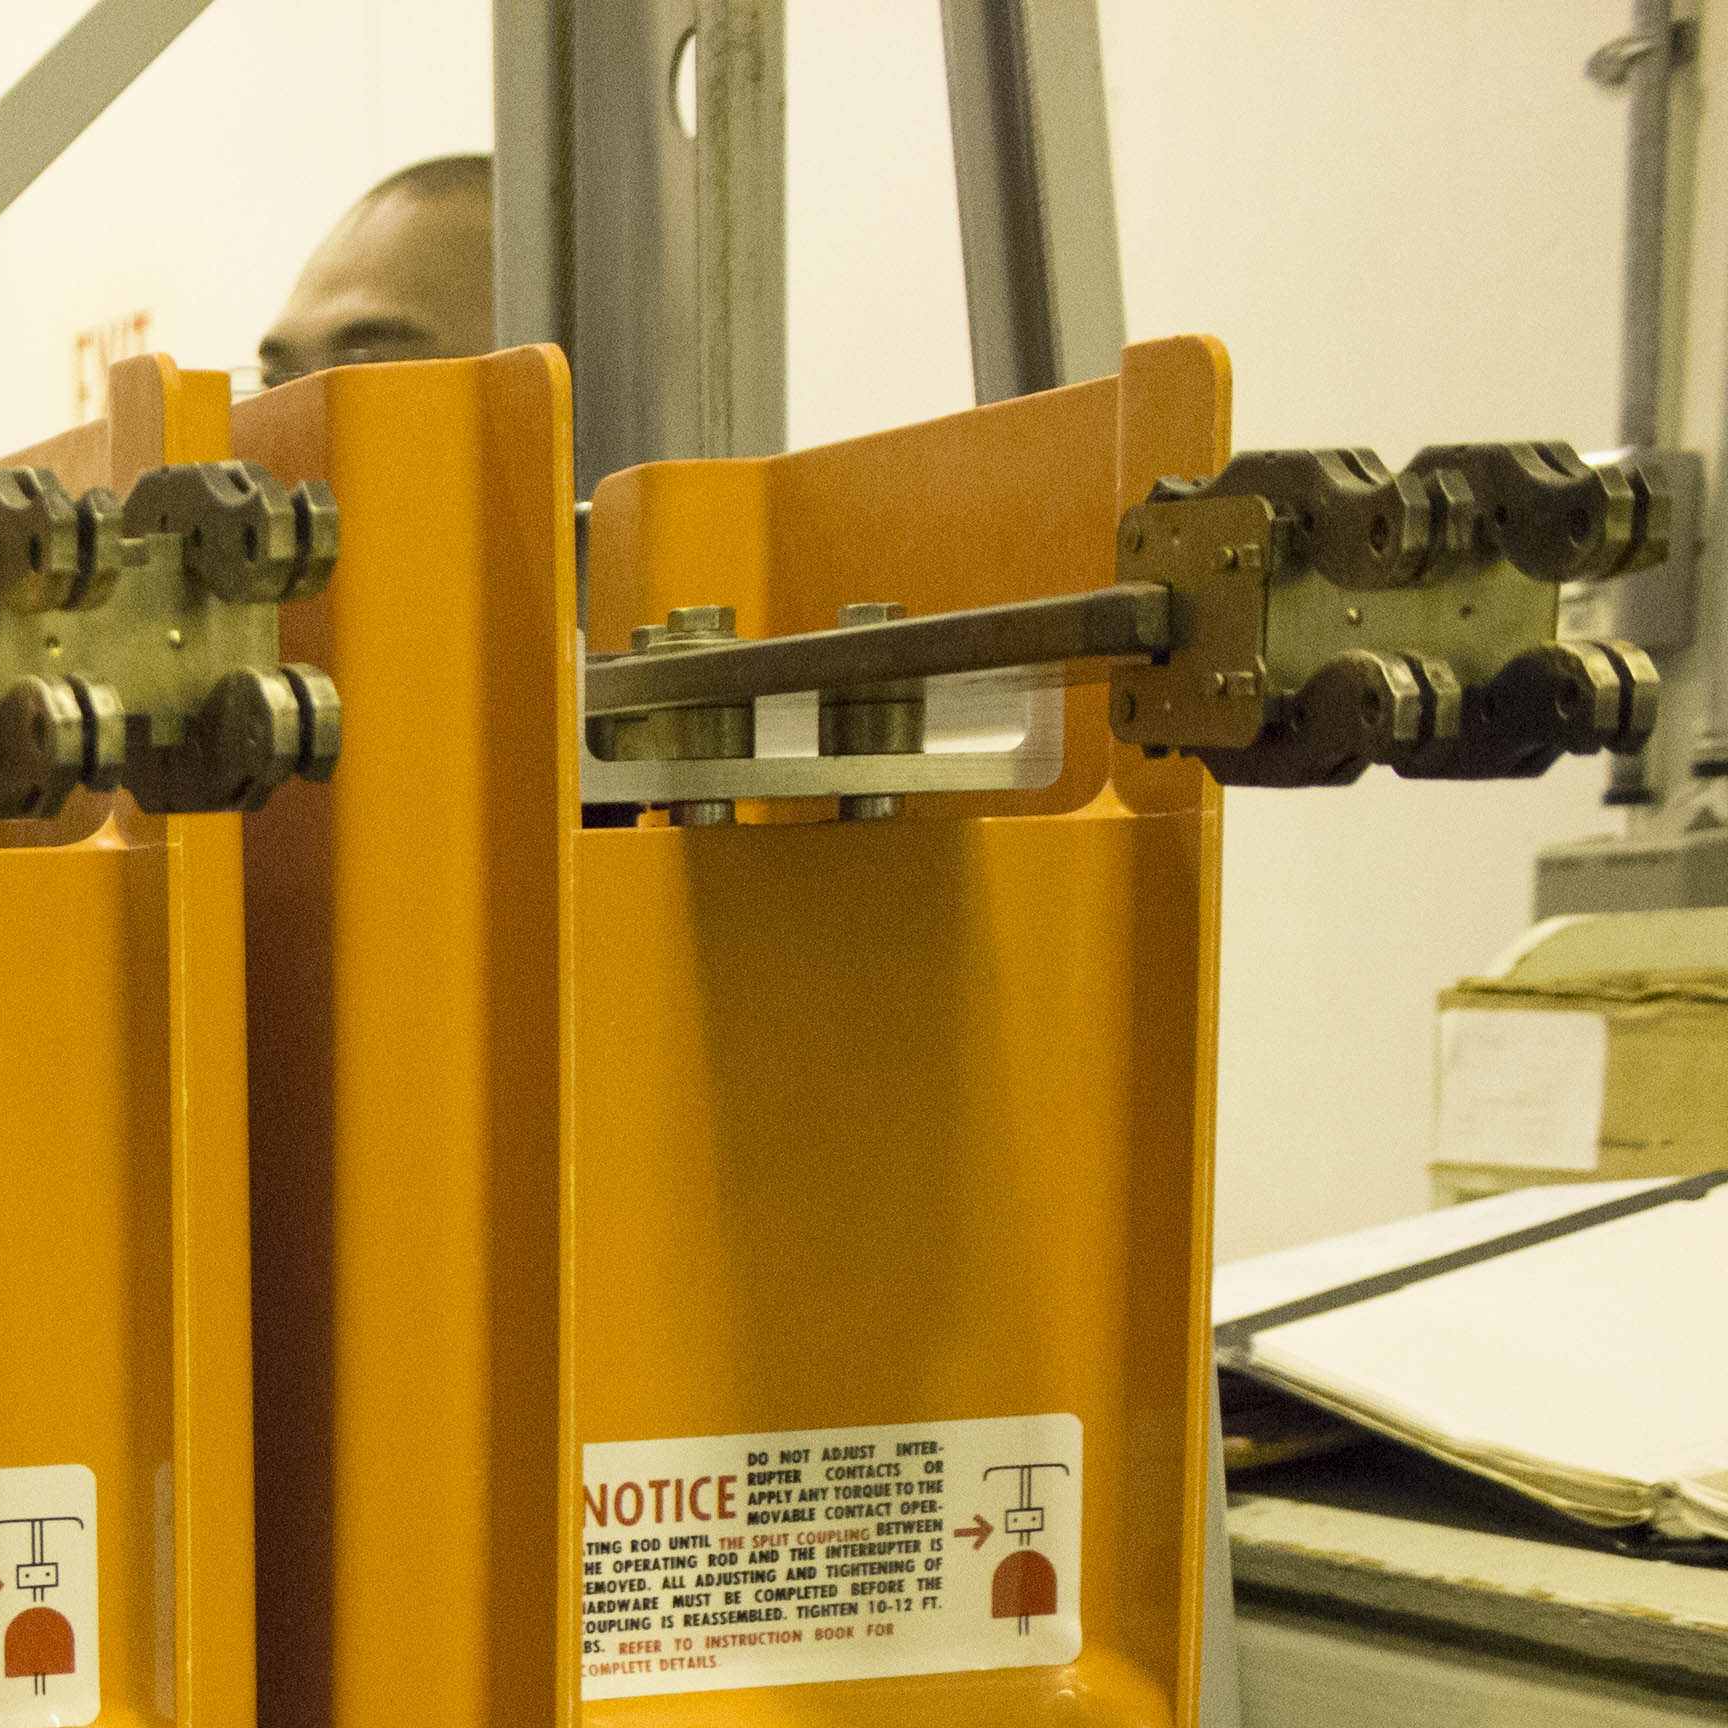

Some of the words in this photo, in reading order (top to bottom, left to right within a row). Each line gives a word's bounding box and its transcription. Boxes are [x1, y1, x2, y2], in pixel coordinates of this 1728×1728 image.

[747, 1452, 768, 1467] DO
[780, 1449, 810, 1465] NOT
[822, 1444, 875, 1462] ADJUST
[896, 1439, 944, 1457] INTER-
[747, 1470, 802, 1487] RUPTER
[825, 1463, 901, 1481] CONTACTS
[924, 1460, 944, 1474] OR
[584, 1474, 738, 1529] NOTICE
[747, 1490, 793, 1507] APPLY
[896, 1481, 914, 1496] TO
[917, 1479, 943, 1495] THE
[747, 1508, 816, 1526] MOVABLE
[825, 1502, 892, 1521] CONTACT
[900, 1499, 944, 1515] OPER-
[630, 1538, 661, 1553] ROD
[669, 1534, 711, 1551] UNTIL
[877, 1518, 943, 1536] BETWEEN
[613, 1555, 698, 1574] OPERATING
[708, 1552, 738, 1567] ROD
[749, 1549, 779, 1564] AND
[789, 1547, 816, 1562] THE
[930, 1538, 943, 1552] IS
[662, 1575, 686, 1590] ALL
[695, 1569, 776, 1588] ADJUSTING
[786, 1566, 817, 1581] AND
[924, 1557, 943, 1572] OF
[673, 1593, 711, 1609] MUST
[725, 1591, 741, 1606] BE
[754, 1584, 838, 1604] COMPLETED
[850, 1580, 904, 1597] BEFORE
[917, 1577, 943, 1592] THE
[661, 1615, 674, 1629] IS
[684, 1607, 788, 1627] REASSEMBLED.
[797, 1602, 858, 1620] TIGHTEN
[869, 1598, 912, 1615] 10-12
[922, 1596, 942, 1611] FT.
